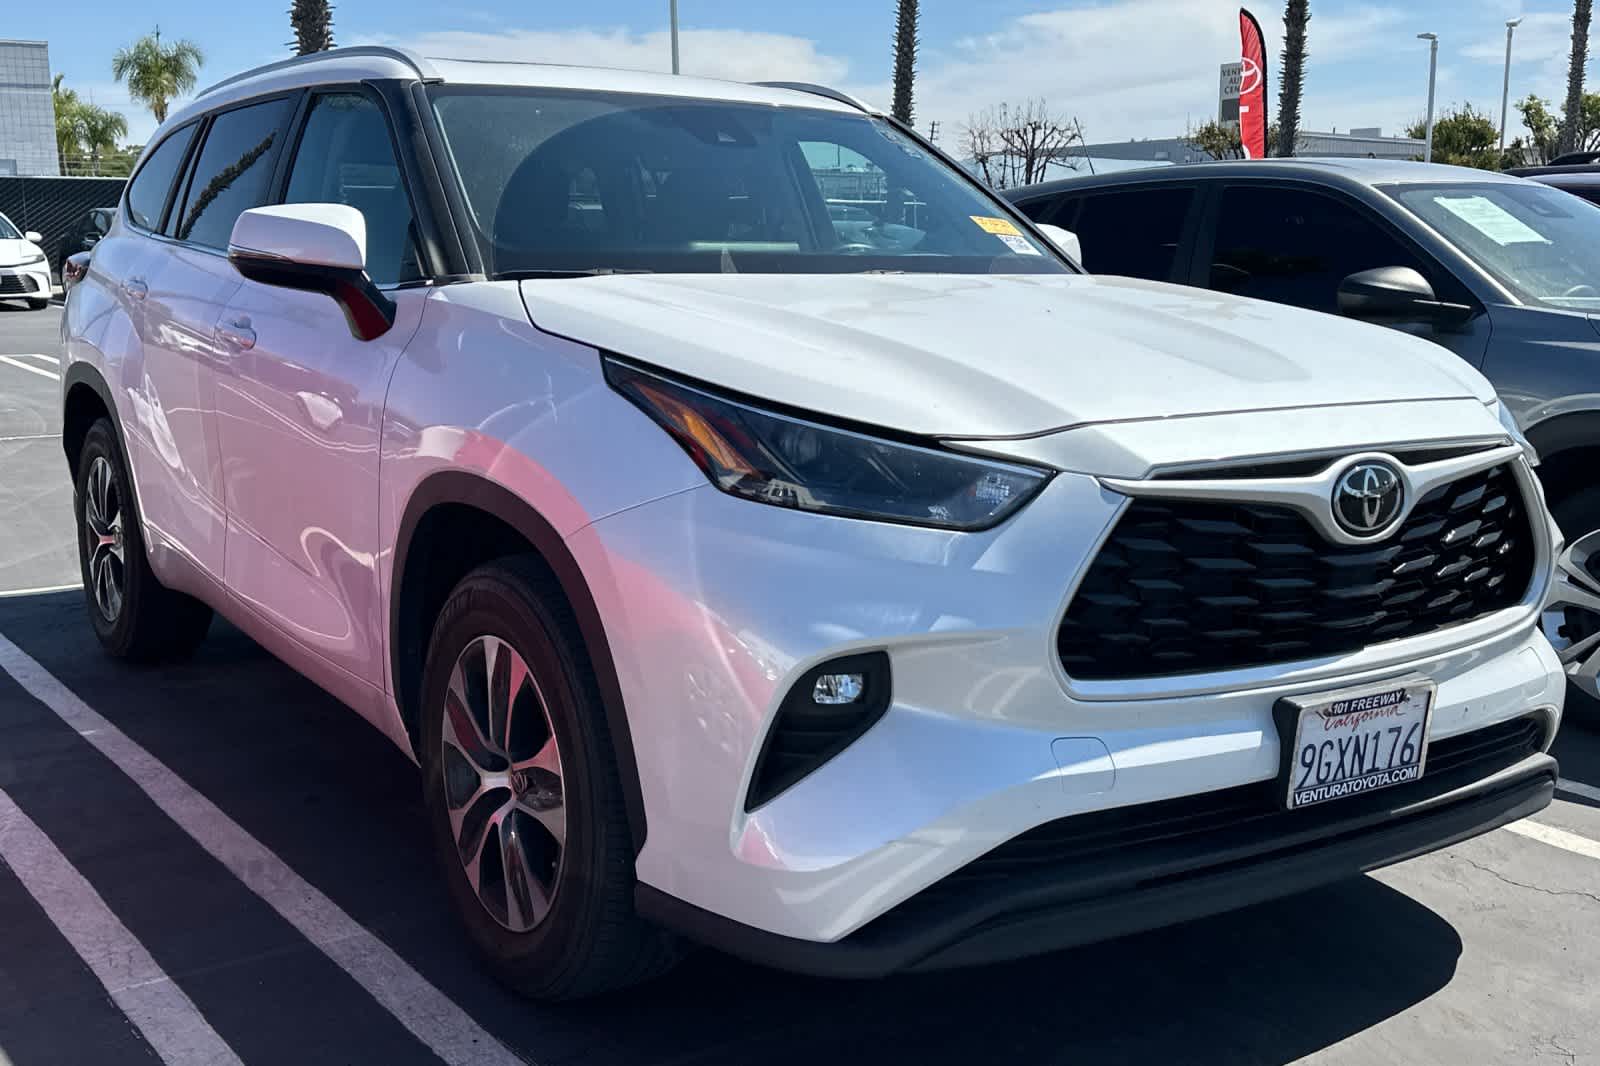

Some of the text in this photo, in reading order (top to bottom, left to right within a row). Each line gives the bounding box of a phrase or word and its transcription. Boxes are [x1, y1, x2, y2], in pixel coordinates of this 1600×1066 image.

[1224, 85, 1240, 95] CEN
[1332, 692, 1402, 715] 101 FREEWAY
[1324, 705, 1406, 733] California
[1297, 722, 1420, 790] 9GXN176
[1294, 766, 1418, 806] VENTURATOYOTA.COM
